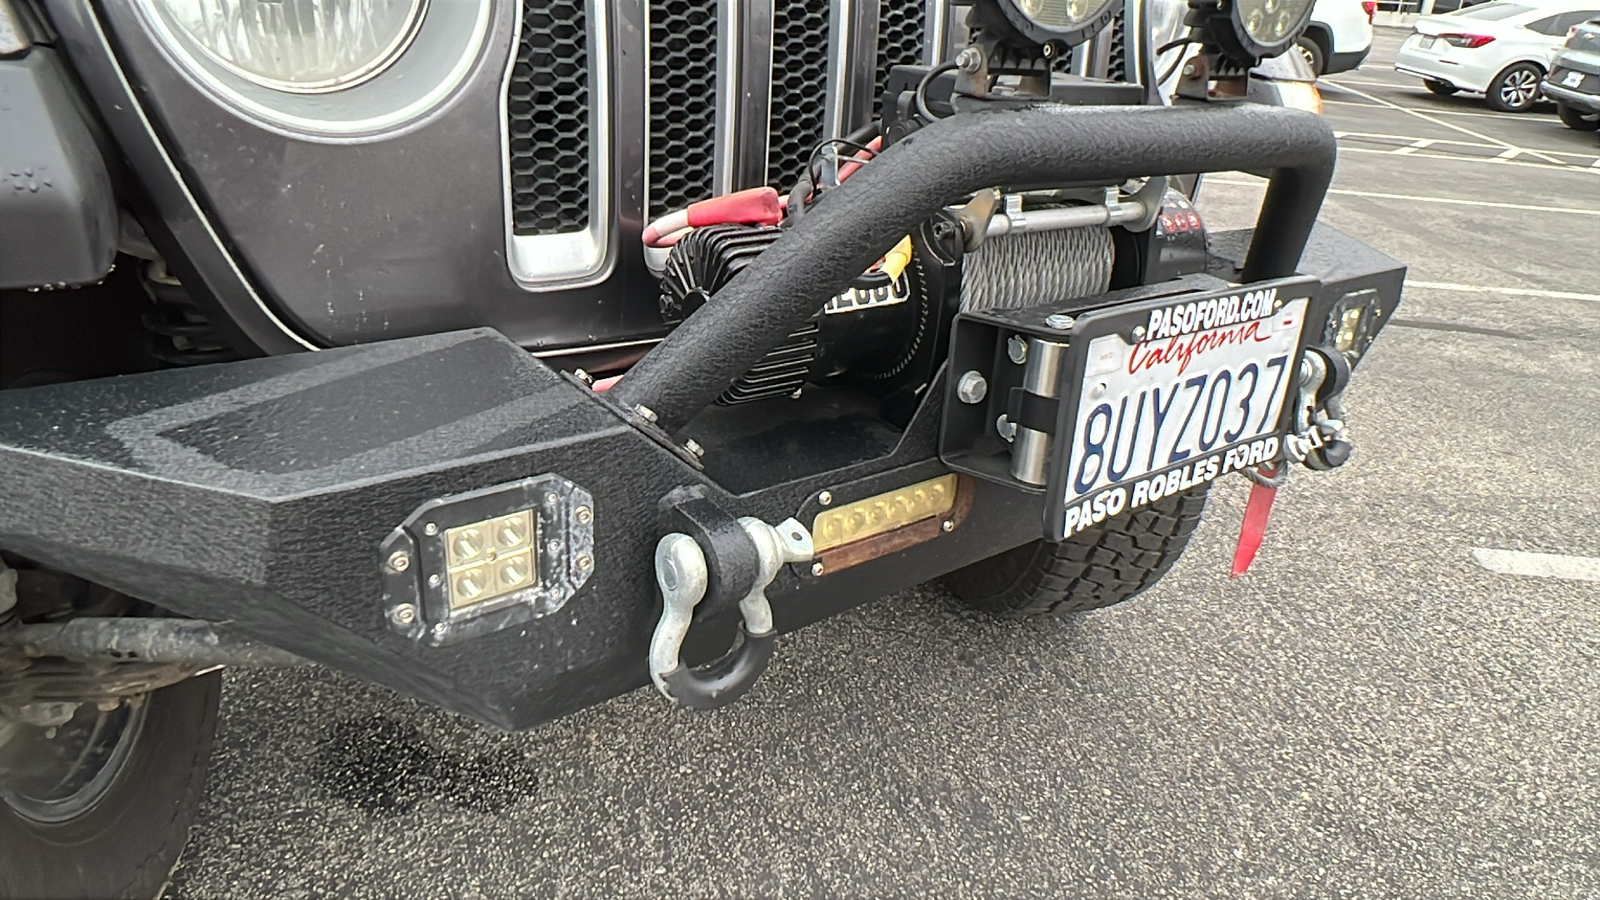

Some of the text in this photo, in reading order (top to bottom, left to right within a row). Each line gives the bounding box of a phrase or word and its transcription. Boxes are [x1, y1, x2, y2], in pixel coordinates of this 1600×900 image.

[1128, 321, 1271, 376] California
[1146, 289, 1276, 341] PASOFORD.COM
[1074, 355, 1288, 494] 8UYZ037
[1064, 437, 1279, 538] PASO ROBLES FORD
